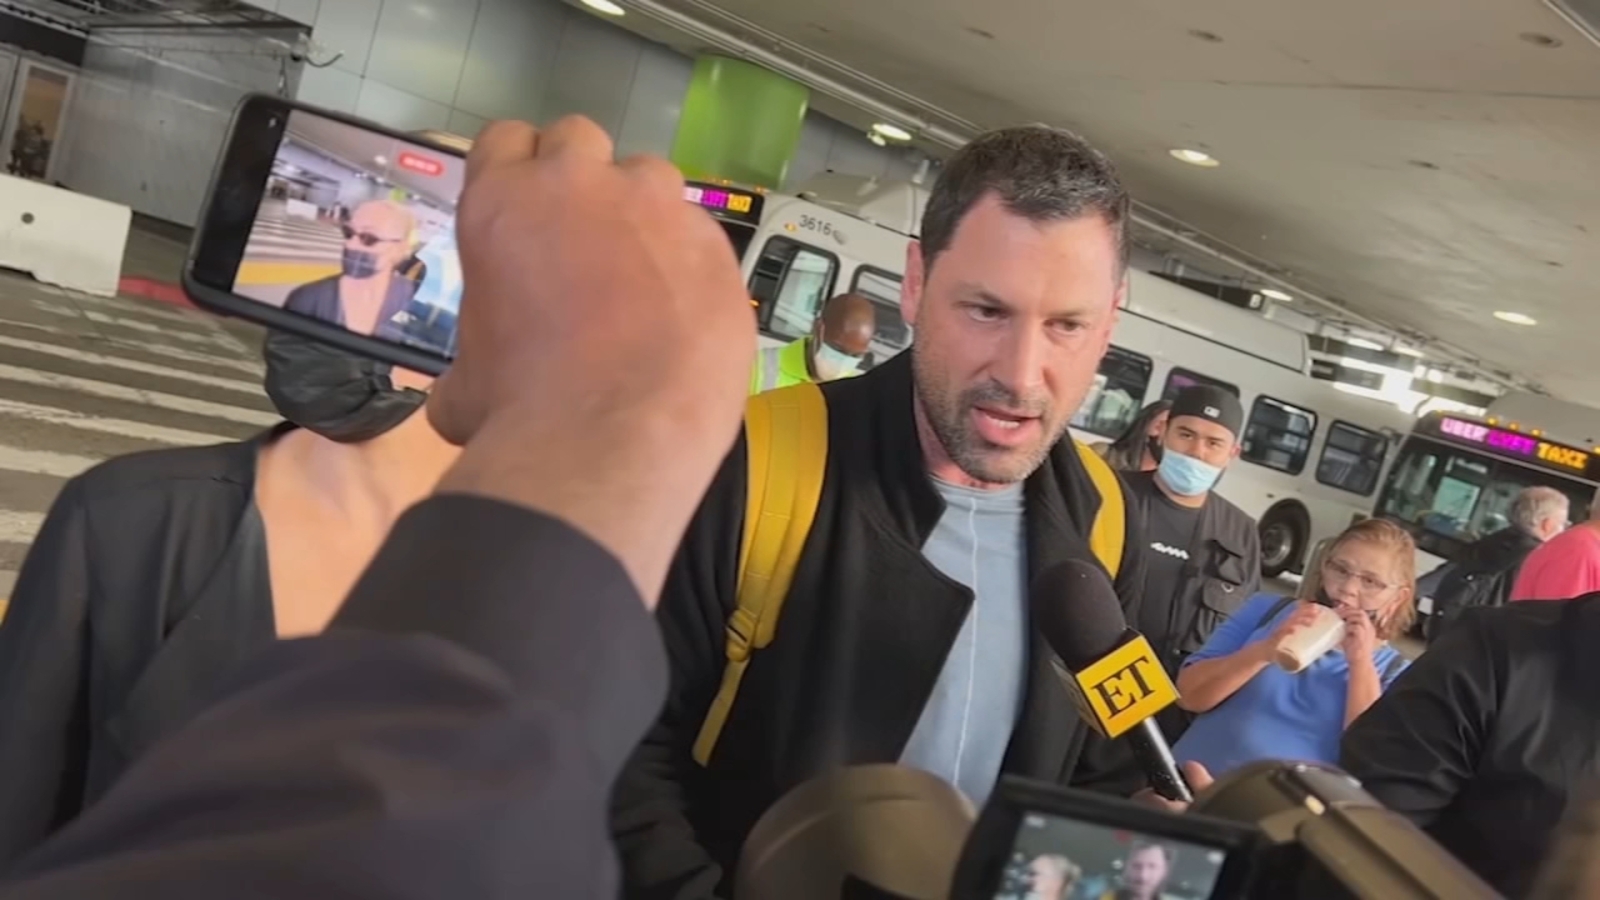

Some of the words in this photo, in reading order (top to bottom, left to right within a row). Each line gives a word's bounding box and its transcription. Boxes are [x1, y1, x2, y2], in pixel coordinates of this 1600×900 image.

[799, 213, 832, 236] 3616
[1440, 417, 1489, 442] UBER
[1537, 442, 1588, 469] TAXI
[1091, 656, 1155, 719] ET
